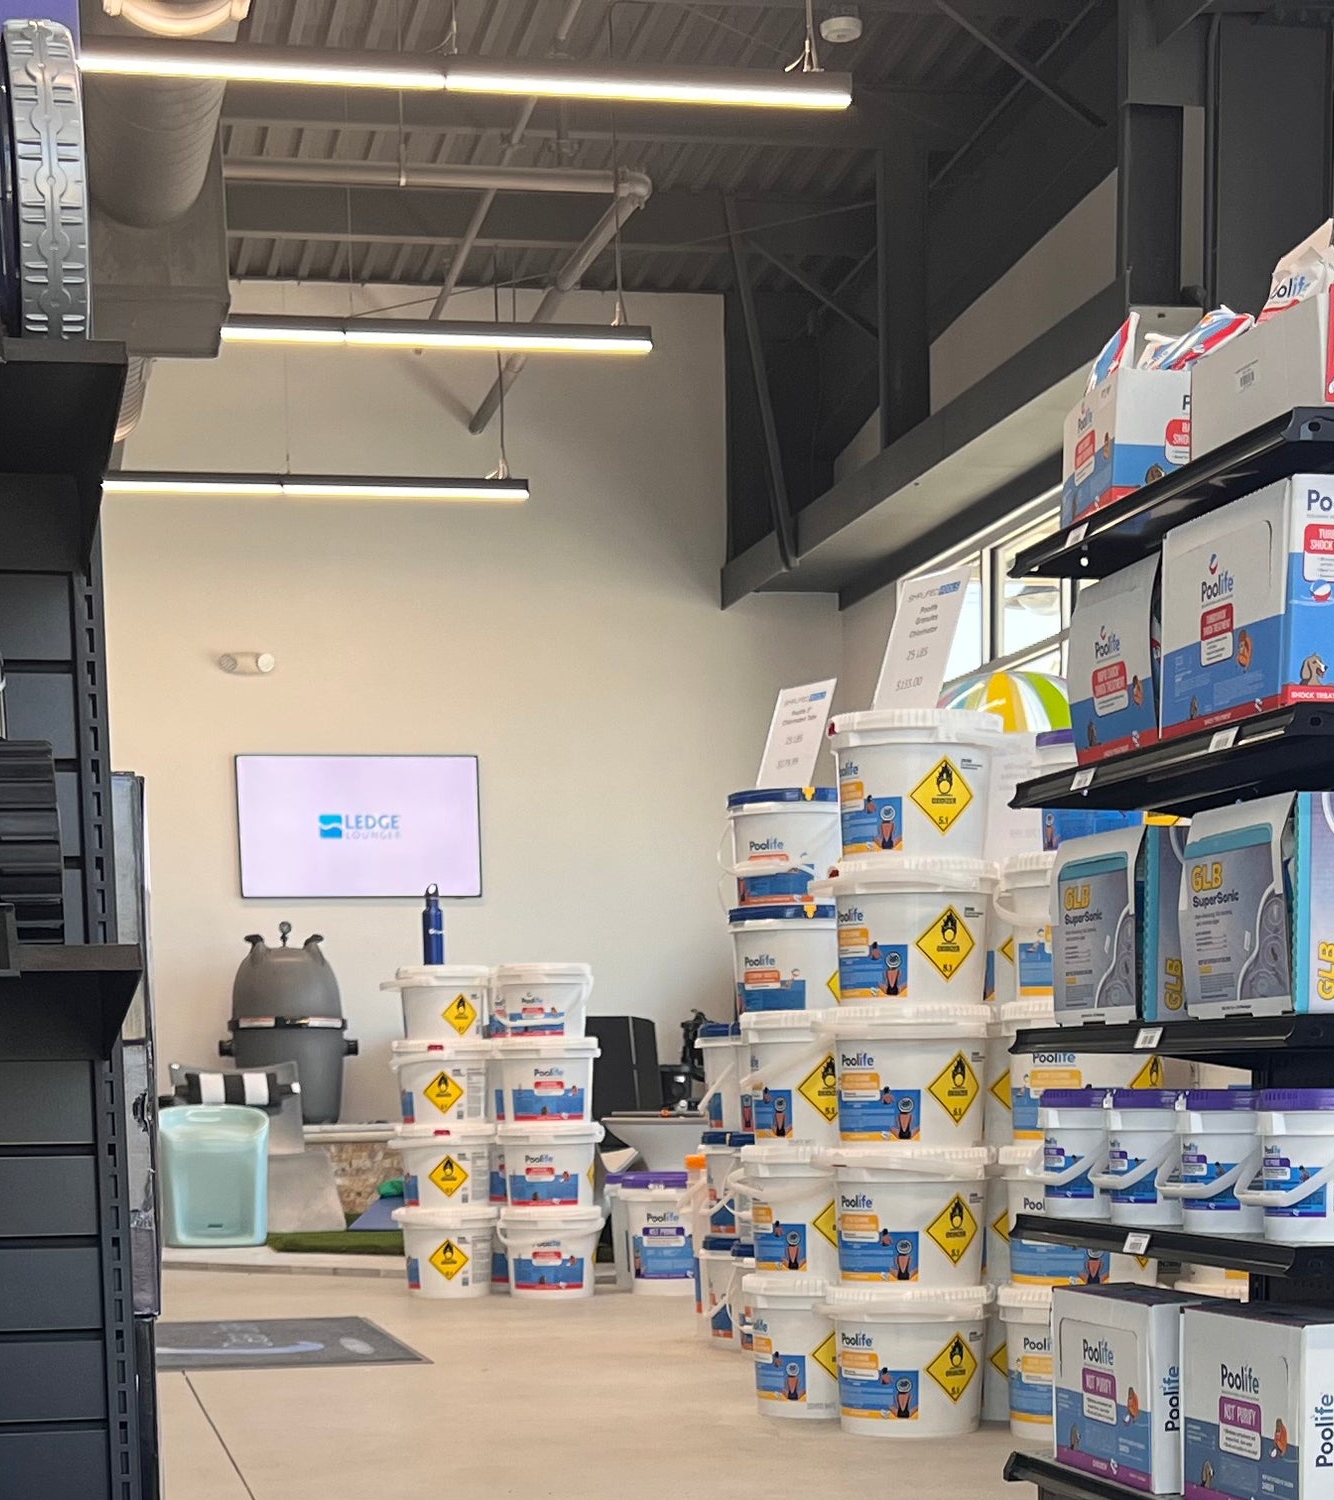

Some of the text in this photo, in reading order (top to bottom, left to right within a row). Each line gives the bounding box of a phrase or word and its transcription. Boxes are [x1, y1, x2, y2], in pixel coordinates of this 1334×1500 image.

[1309, 541, 1334, 553] SHOCK
[1201, 570, 1235, 603] Poolife
[1094, 633, 1121, 660] Poolife
[1290, 691, 1315, 700] SHOCK
[345, 814, 402, 830] LEDGE
[938, 816, 949, 826] 5.1
[749, 836, 785, 852] Poolife
[1191, 861, 1224, 893] GLB
[1063, 883, 1091, 911] GLB
[1192, 888, 1240, 908] SuperSonic
[1064, 908, 1103, 926] SuperSonic
[744, 954, 776, 968] Poolife
[1164, 957, 1184, 1011] GLB
[841, 1051, 874, 1067] Poolife
[841, 1194, 874, 1209] Poolife
[646, 1211, 680, 1223] Poolife
[841, 1332, 874, 1348] Poolife
[1082, 1337, 1115, 1366] Poolife
[1220, 1362, 1260, 1395] Poolife
[1223, 1402, 1256, 1426] NST PURIFY
[1313, 1393, 1334, 1467] Poolife
